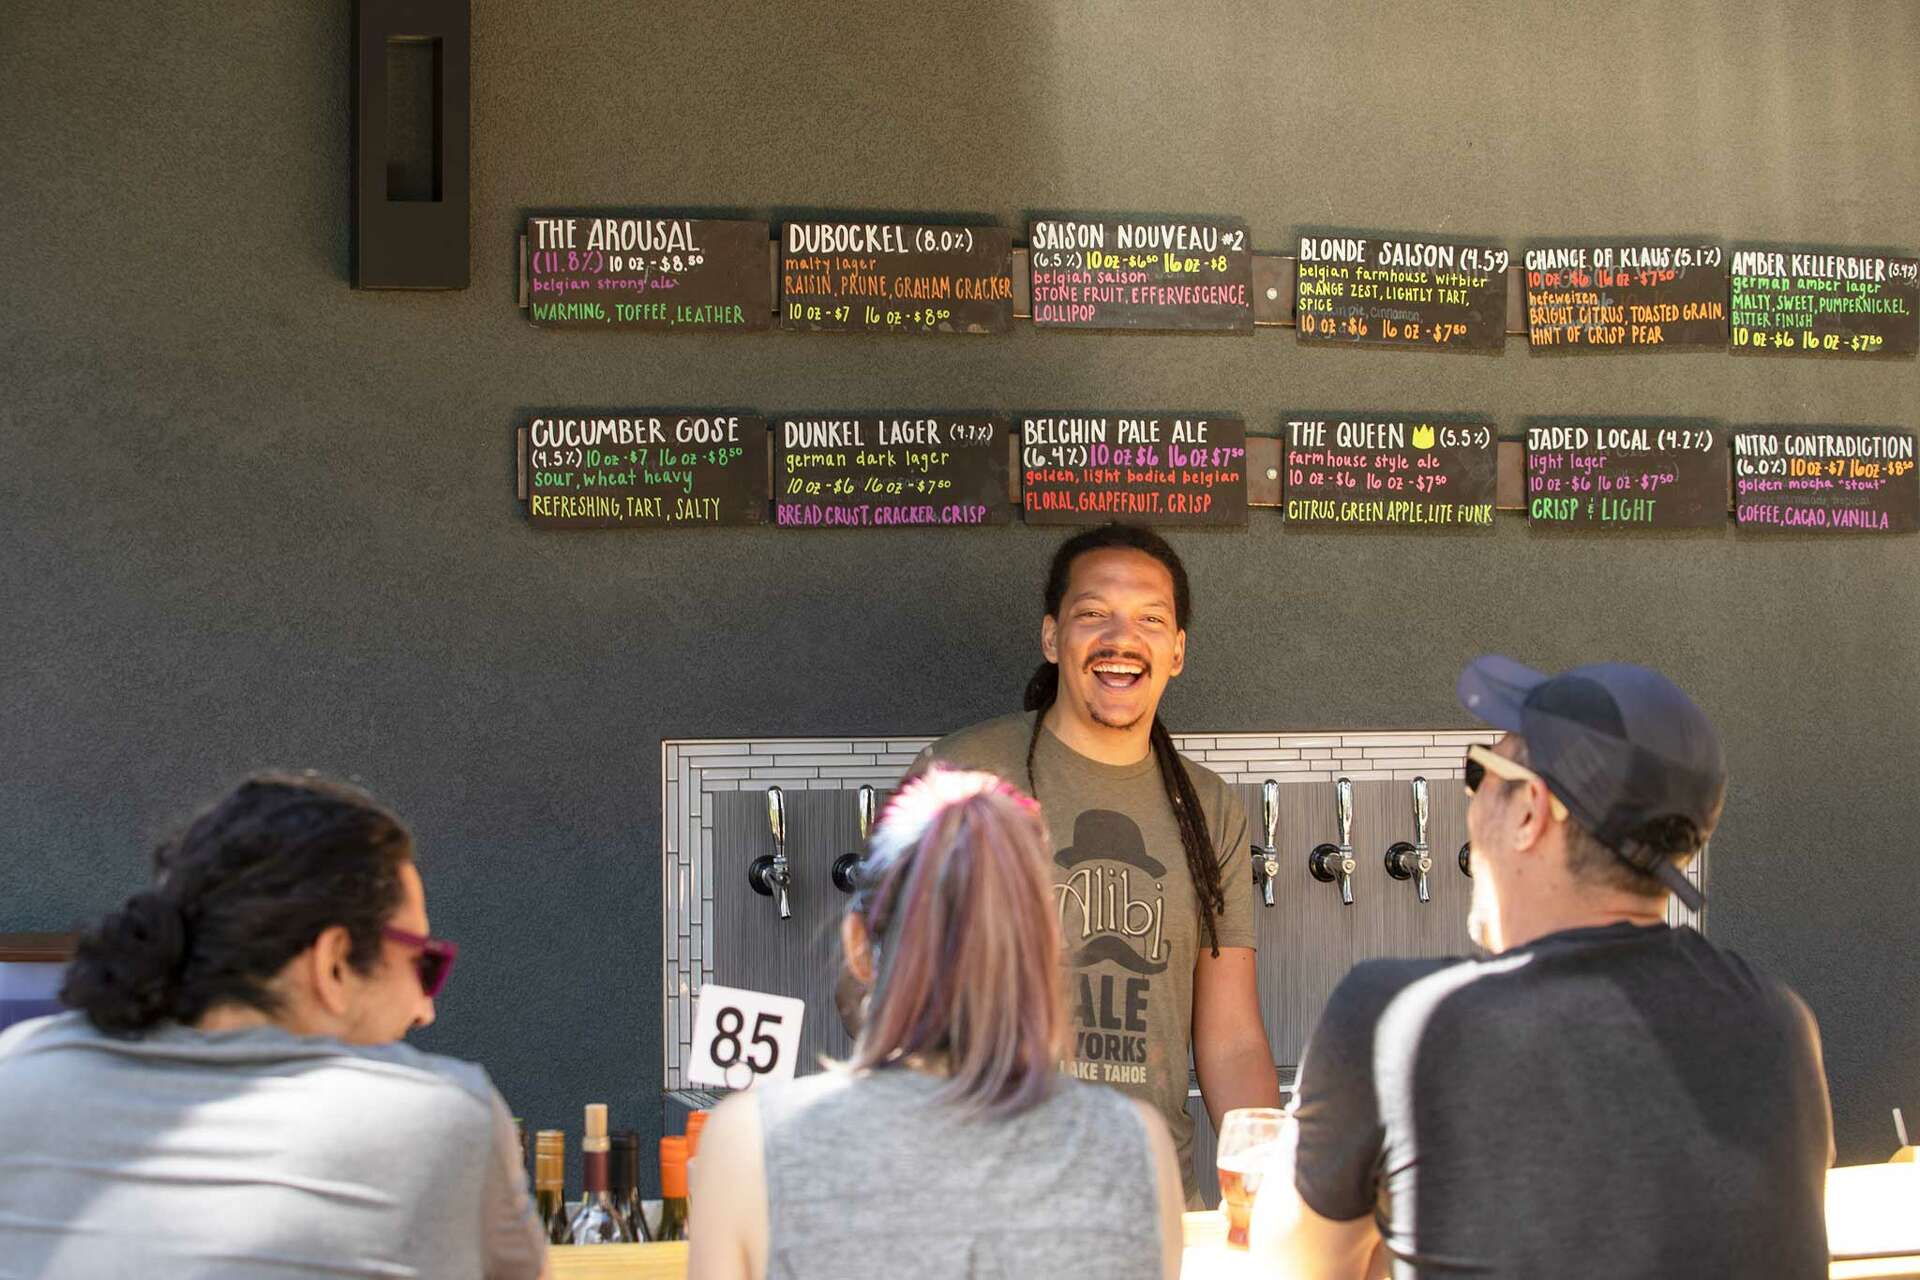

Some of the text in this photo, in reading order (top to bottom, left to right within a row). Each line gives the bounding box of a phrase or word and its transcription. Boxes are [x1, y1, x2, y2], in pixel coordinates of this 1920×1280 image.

[535, 219, 700, 253] THE AROUSAL
[789, 224, 973, 253] DUBOCKEL (8.0%)
[1033, 222, 1244, 252] SAISON NOUVEAU #2
[533, 251, 604, 273] (11.8%)
[1300, 238, 1367, 262] BLONDE
[1379, 242, 1453, 267] SAISON
[1526, 249, 1587, 270] CHANCE
[1621, 247, 1671, 268] KLAUS
[785, 257, 876, 277] malty lager
[1300, 264, 1488, 288] belgian farmhouse witbier
[1732, 252, 1787, 277] AMBER
[1792, 253, 1886, 281] KELLERBIER
[533, 276, 674, 296] belgian strong ale
[895, 276, 950, 299] GRAHAM
[956, 275, 1013, 299] CRACKER
[1034, 271, 1147, 288] belgian saison
[1733, 277, 1881, 299] german amber lager
[1034, 286, 1077, 302] STONE
[1300, 281, 1470, 307] ORANGE ZEST, LIGHTLY TART,
[1300, 298, 1333, 311] SPICE
[1529, 292, 1598, 305] hefeweizen
[533, 303, 611, 323] WARMING,
[678, 305, 744, 323] LEATHER
[789, 304, 801, 320] 10
[865, 306, 880, 323] 16
[1035, 304, 1095, 322] LOLLIPOP
[1530, 302, 1726, 325] BRIGHT CITRUS, TOASTED GRAIN,
[1732, 312, 1812, 328] BITTER FINISH
[1301, 314, 1315, 332] 10
[1383, 319, 1398, 337] 16
[1531, 325, 1664, 345] HINT OF CRISP PEAR
[1733, 328, 1819, 349] 10 16
[531, 417, 739, 447] CUCUMBER GOSE
[785, 421, 865, 448] DUNKEL
[879, 420, 941, 445] LAGER
[1024, 419, 1208, 445] BELCHIN PALE ALE
[1288, 422, 1490, 449] THE QUEEN (5.5%)
[1529, 427, 1713, 452] JADED LOCAL (4.2%)
[1024, 446, 1087, 468] (6.4%)
[1090, 444, 1110, 467] 10
[1168, 444, 1187, 468] 16
[1735, 434, 1912, 459] NITRO CONTRADICTION
[587, 450, 600, 467] 10
[659, 449, 676, 466] 16
[786, 451, 950, 473] german dark lager
[1375, 455, 1409, 473] style
[1417, 454, 1440, 469] ale
[1530, 454, 1607, 475] light lager
[535, 469, 693, 494] sour, wheat heavy
[1027, 469, 1239, 488] golden, light bodied belgian
[1289, 471, 1382, 489] 10 16
[1530, 476, 1612, 491] 10 16
[1738, 479, 1782, 495] golden
[1788, 478, 1833, 490] mocha
[532, 496, 623, 520] REFRESHING,
[676, 497, 720, 520] SALTY
[778, 504, 822, 525] BREAD
[942, 505, 986, 524] CRISP
[1168, 494, 1211, 513] CRISP
[1341, 502, 1383, 521] GREEN
[1429, 505, 1453, 522] LITE
[1458, 504, 1493, 523] FUNK
[1532, 498, 1579, 520] CRISP
[1602, 499, 1656, 522] LIGHT
[1832, 510, 1888, 529] VANILLA
[1053, 864, 1164, 960] Alibi
[710, 1006, 782, 1075] 85
[1103, 1063, 1147, 1084] TAHOE
